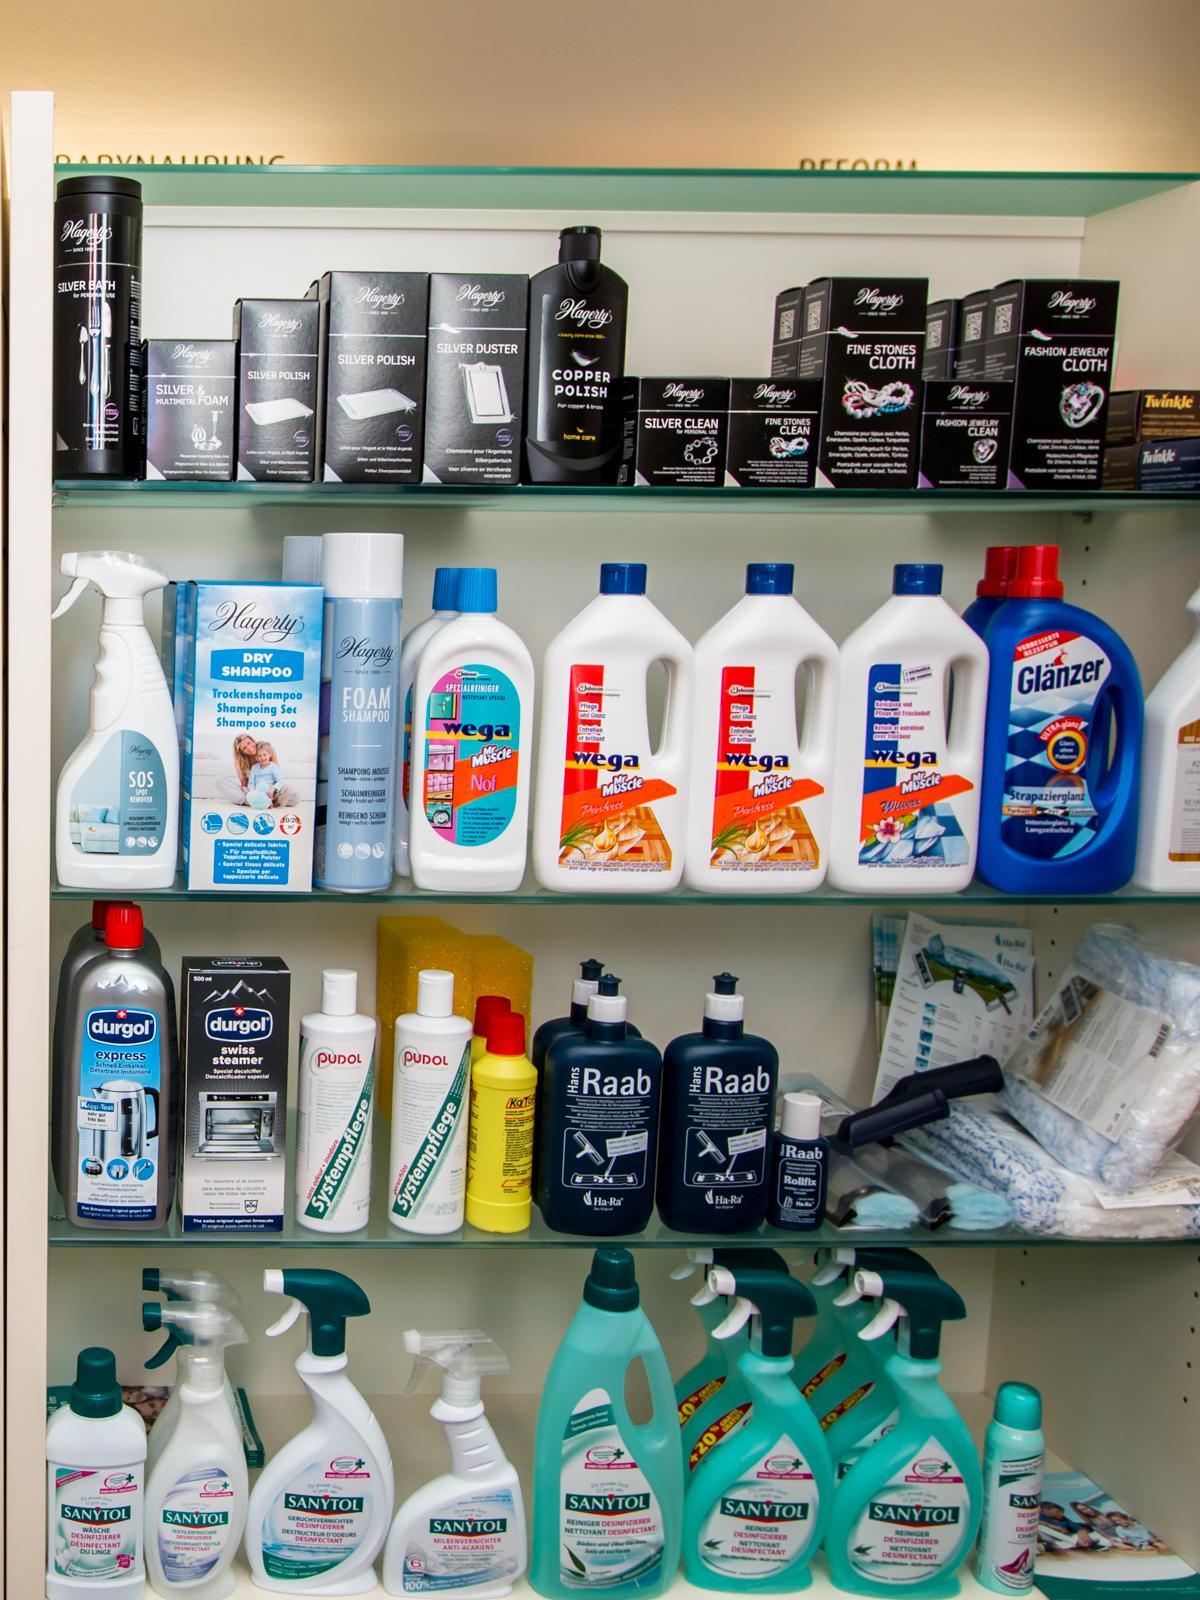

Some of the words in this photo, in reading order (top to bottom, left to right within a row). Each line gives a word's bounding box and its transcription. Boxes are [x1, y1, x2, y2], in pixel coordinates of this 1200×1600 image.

[61, 219, 112, 245] Hagerty
[58, 281, 86, 293] SILVER
[89, 280, 116, 291] BATH
[354, 286, 405, 308] Hagerty
[456, 285, 505, 307] Hagerty
[854, 288, 903, 309] Hagerty
[1048, 291, 1096, 314] Hagerty
[555, 299, 612, 328] Hagerty
[437, 344, 473, 353] SILVER
[476, 344, 518, 353] DUSTER
[847, 345, 872, 354] FINE
[874, 345, 916, 355] STONES
[1024, 348, 1066, 356] FASHION
[1068, 348, 1109, 357] JEWELRY
[338, 355, 374, 365] SILVER
[376, 355, 415, 365] POLISH
[869, 357, 915, 369] CLOTH
[1062, 359, 1108, 372] CLOTH
[248, 371, 277, 380] SILVER
[279, 371, 310, 380] POLISH
[552, 370, 611, 383] COPPER
[156, 385, 194, 395] SILVER
[197, 385, 205, 395] &
[554, 385, 608, 397] POLISH
[198, 396, 228, 405] FOAM
[1144, 393, 1194, 410] Twinkle
[645, 419, 682, 429] SILVER
[685, 419, 719, 429] CLEAN
[780, 426, 810, 435] CLEAN
[968, 427, 998, 436] CLEAN
[1142, 449, 1176, 463] Twinkle
[208, 601, 304, 643] Hagerty
[337, 636, 394, 667] Hagerty
[1023, 641, 1058, 657] REZEPTUR
[243, 653, 273, 663] DRY
[222, 667, 292, 678] SHAMPOO
[1017, 658, 1104, 695] Glänzer
[445, 684, 499, 692] SPEZIALREINIGER
[213, 689, 302, 703] Trockenshampoo
[343, 687, 390, 709] FOAM
[217, 703, 277, 716] Shampoing
[281, 703, 296, 713] Sec
[343, 710, 389, 723] SHAMPOO
[216, 717, 266, 730] Shampoo
[270, 719, 296, 729] secco
[443, 722, 510, 741] wega
[471, 747, 512, 768] Muscle
[483, 745, 495, 755] Mr
[573, 752, 639, 772] wega
[725, 753, 789, 772] wega
[872, 750, 937, 769] wega
[129, 771, 154, 788] SOS
[470, 774, 497, 791] Nof
[602, 776, 643, 797] Muscle
[753, 776, 792, 797] Muscle
[901, 773, 941, 795] Muscle
[1010, 790, 1084, 804] Strapazierglanz
[92, 1019, 150, 1038] durgol
[210, 1017, 266, 1036] durgol
[96, 1051, 146, 1062] express
[221, 1046, 255, 1055] swiss
[213, 1056, 263, 1065] steamer
[317, 1052, 362, 1067] PUDOL
[404, 1051, 448, 1066] PUDOL
[567, 1066, 580, 1094] Hans
[583, 1068, 651, 1095] Raab
[705, 1066, 770, 1094] Raab
[311, 1098, 369, 1213] Systempflege
[398, 1102, 456, 1212] Systempflege
[784, 1175, 817, 1186] Rollfix
[593, 1196, 620, 1207] Ha-Ra
[288, 1495, 360, 1511] SANYTOL
[569, 1495, 646, 1510] SANYTOL
[725, 1500, 805, 1519] SANYTOL
[64, 1508, 128, 1520] SANYTOL
[873, 1505, 956, 1523] SANYTOL
[82, 1526, 110, 1534] WÄSCHE
[433, 1519, 503, 1533] SANYTOL
